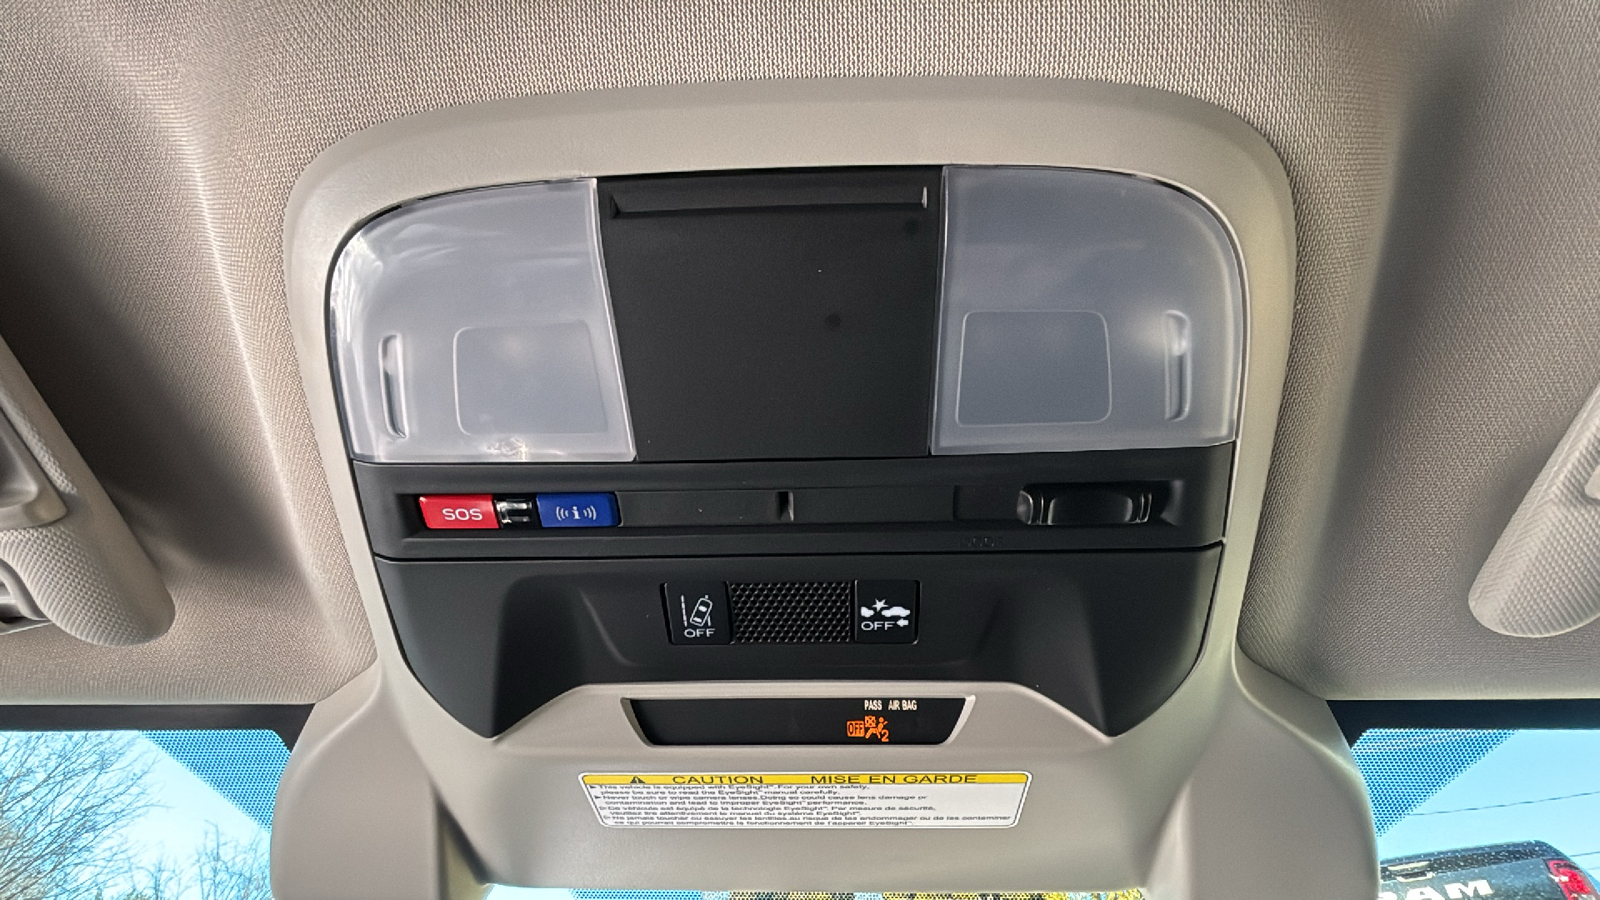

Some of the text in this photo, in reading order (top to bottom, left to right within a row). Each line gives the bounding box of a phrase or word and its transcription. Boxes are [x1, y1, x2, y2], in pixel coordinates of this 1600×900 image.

[442, 508, 483, 521] SOS
[861, 621, 895, 631] OFF
[684, 628, 715, 638] OFF
[864, 699, 918, 711] PASS AIR BAG
[848, 721, 864, 737] OFF
[672, 775, 977, 784] CAUTION MISE EN GARDE
